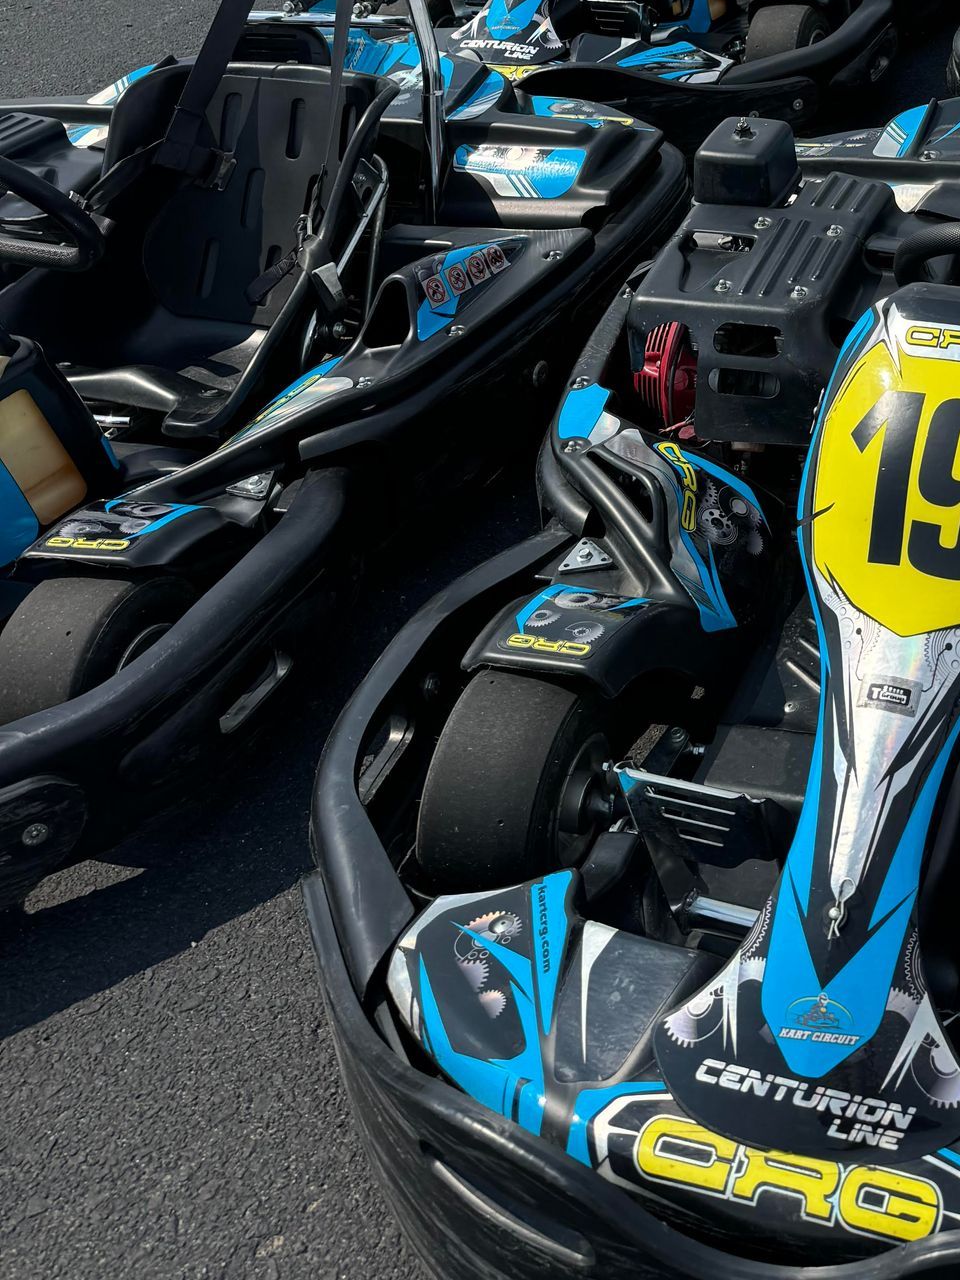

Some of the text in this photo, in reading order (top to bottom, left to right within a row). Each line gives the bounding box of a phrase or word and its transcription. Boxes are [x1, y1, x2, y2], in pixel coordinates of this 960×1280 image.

[460, 39, 540, 56] CENTURION
[504, 51, 534, 61] LINE
[656, 441, 697, 533] CRG
[45, 536, 131, 551] CRG
[508, 633, 592, 657] CRG
[537, 884, 550, 974] kartcrg.com
[779, 1026, 861, 1047] KART CIRCUIT
[694, 1057, 918, 1132] CENTURION
[826, 1119, 906, 1151] LINE
[636, 1113, 944, 1244] CRG
